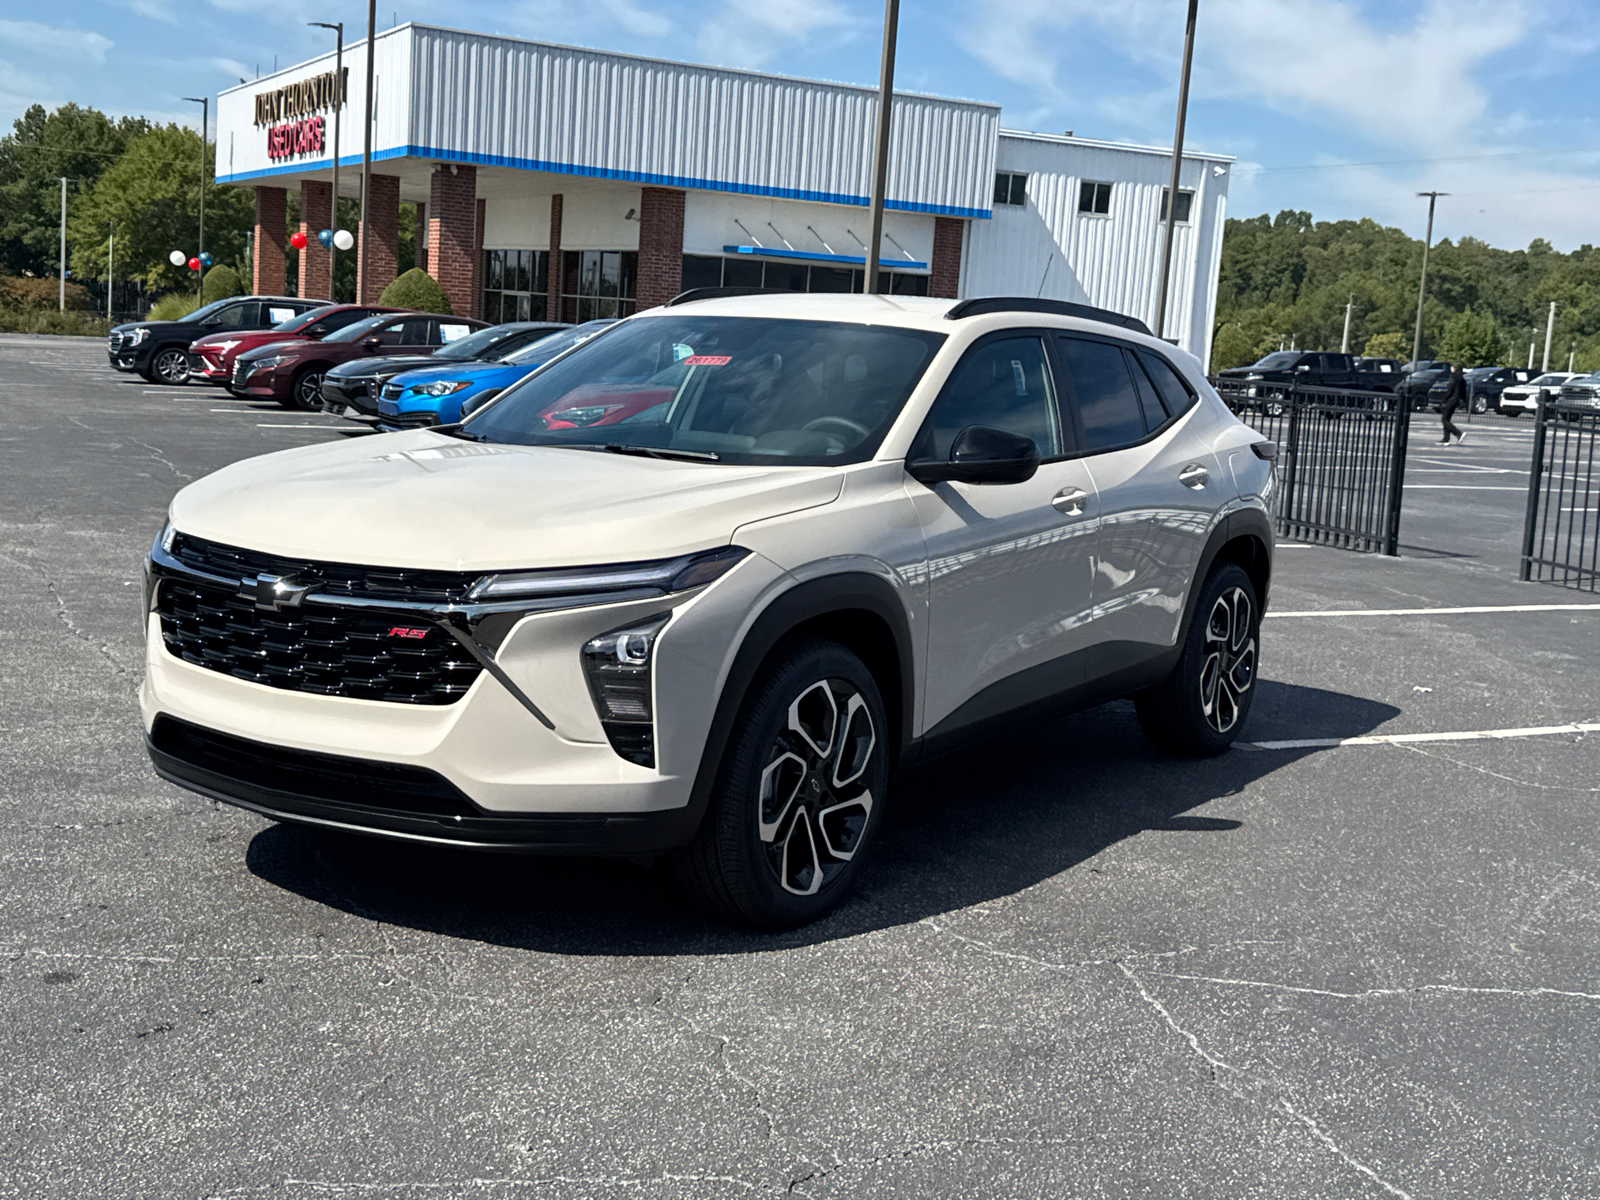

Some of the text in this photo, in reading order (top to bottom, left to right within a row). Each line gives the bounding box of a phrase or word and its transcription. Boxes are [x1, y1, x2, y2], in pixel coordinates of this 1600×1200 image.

[253, 90, 280, 126] JOHN
[267, 115, 322, 159] USED CARS
[388, 627, 427, 639] RS
